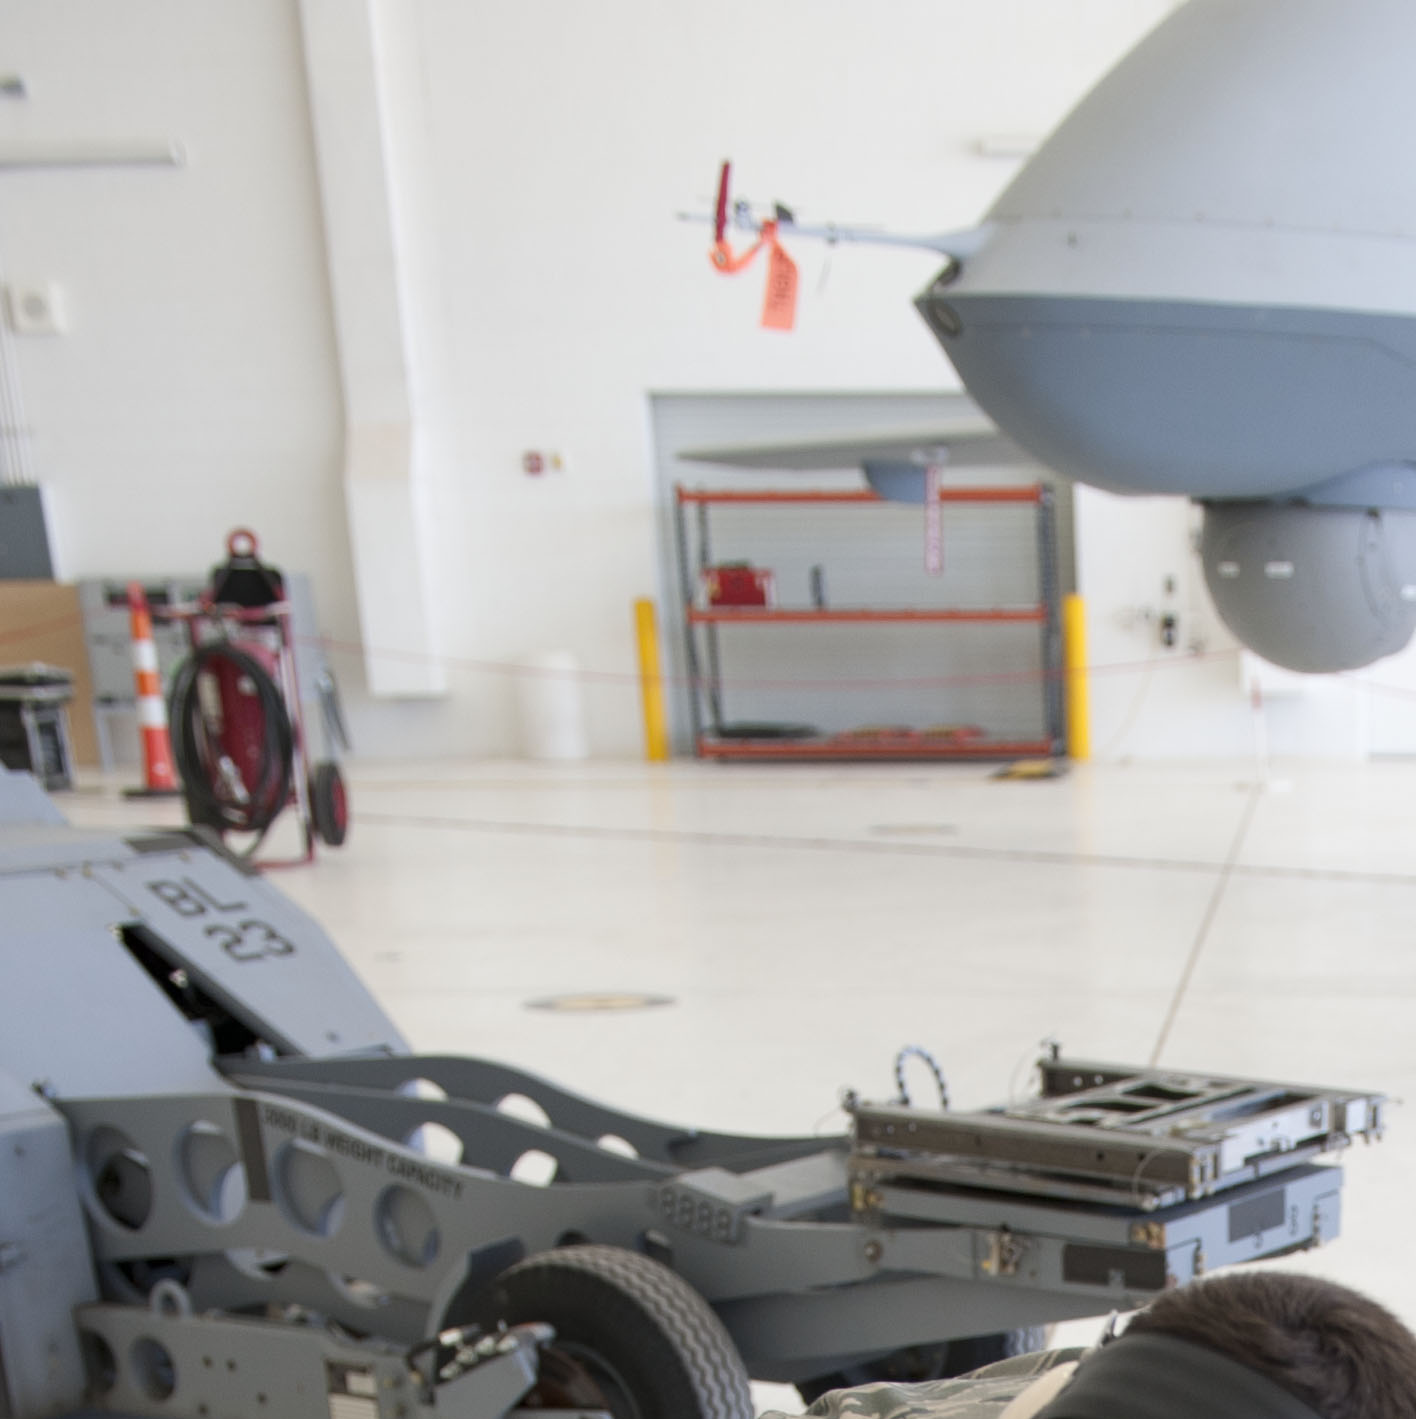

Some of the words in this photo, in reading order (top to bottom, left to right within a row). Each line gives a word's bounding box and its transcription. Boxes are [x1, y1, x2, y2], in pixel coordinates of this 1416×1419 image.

[144, 875, 249, 917] BL
[203, 918, 297, 962] 23
[326, 1131, 386, 1168] WEIGHT
[387, 1153, 464, 1198] CAPACITY
